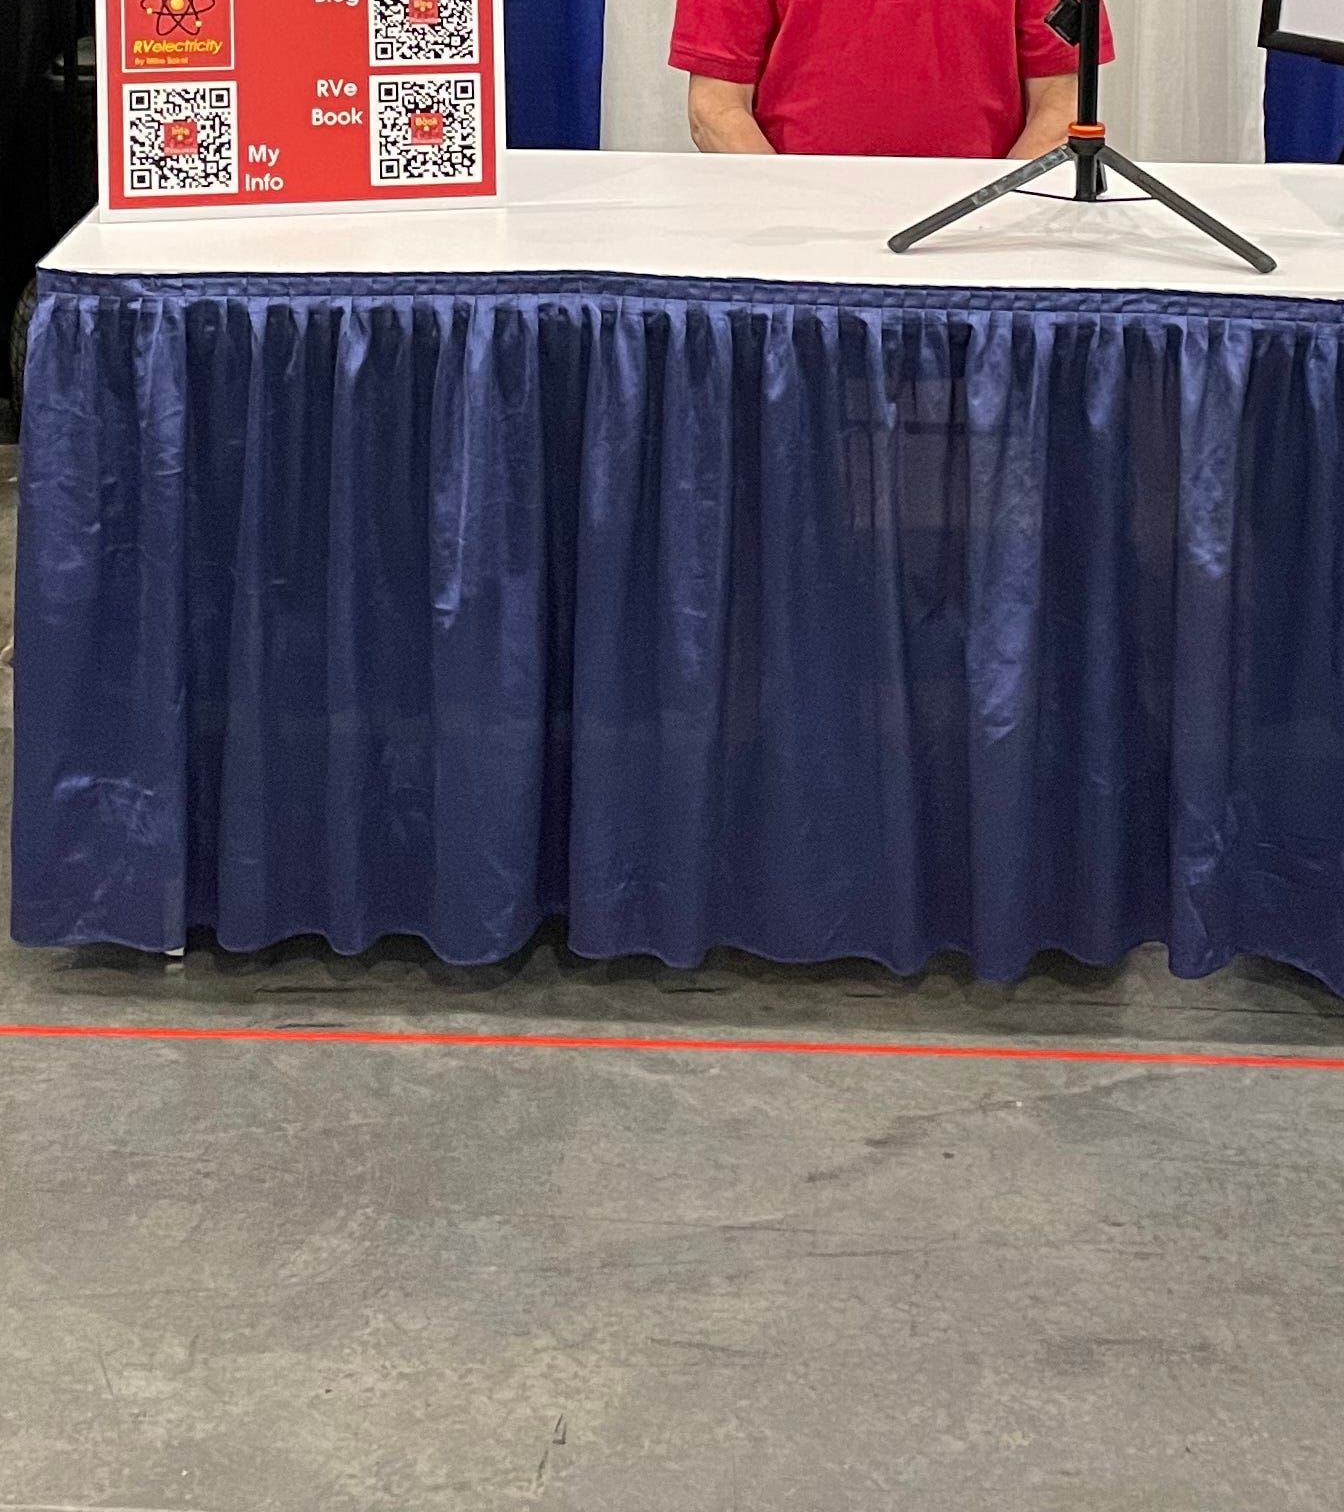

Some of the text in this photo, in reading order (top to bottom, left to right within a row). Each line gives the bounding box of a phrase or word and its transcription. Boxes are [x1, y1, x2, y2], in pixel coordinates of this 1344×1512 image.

[133, 39, 223, 55] RVelectricity
[316, 79, 358, 98] RVe
[311, 108, 363, 127] Book
[248, 145, 280, 168] My
[245, 173, 284, 193] Info
